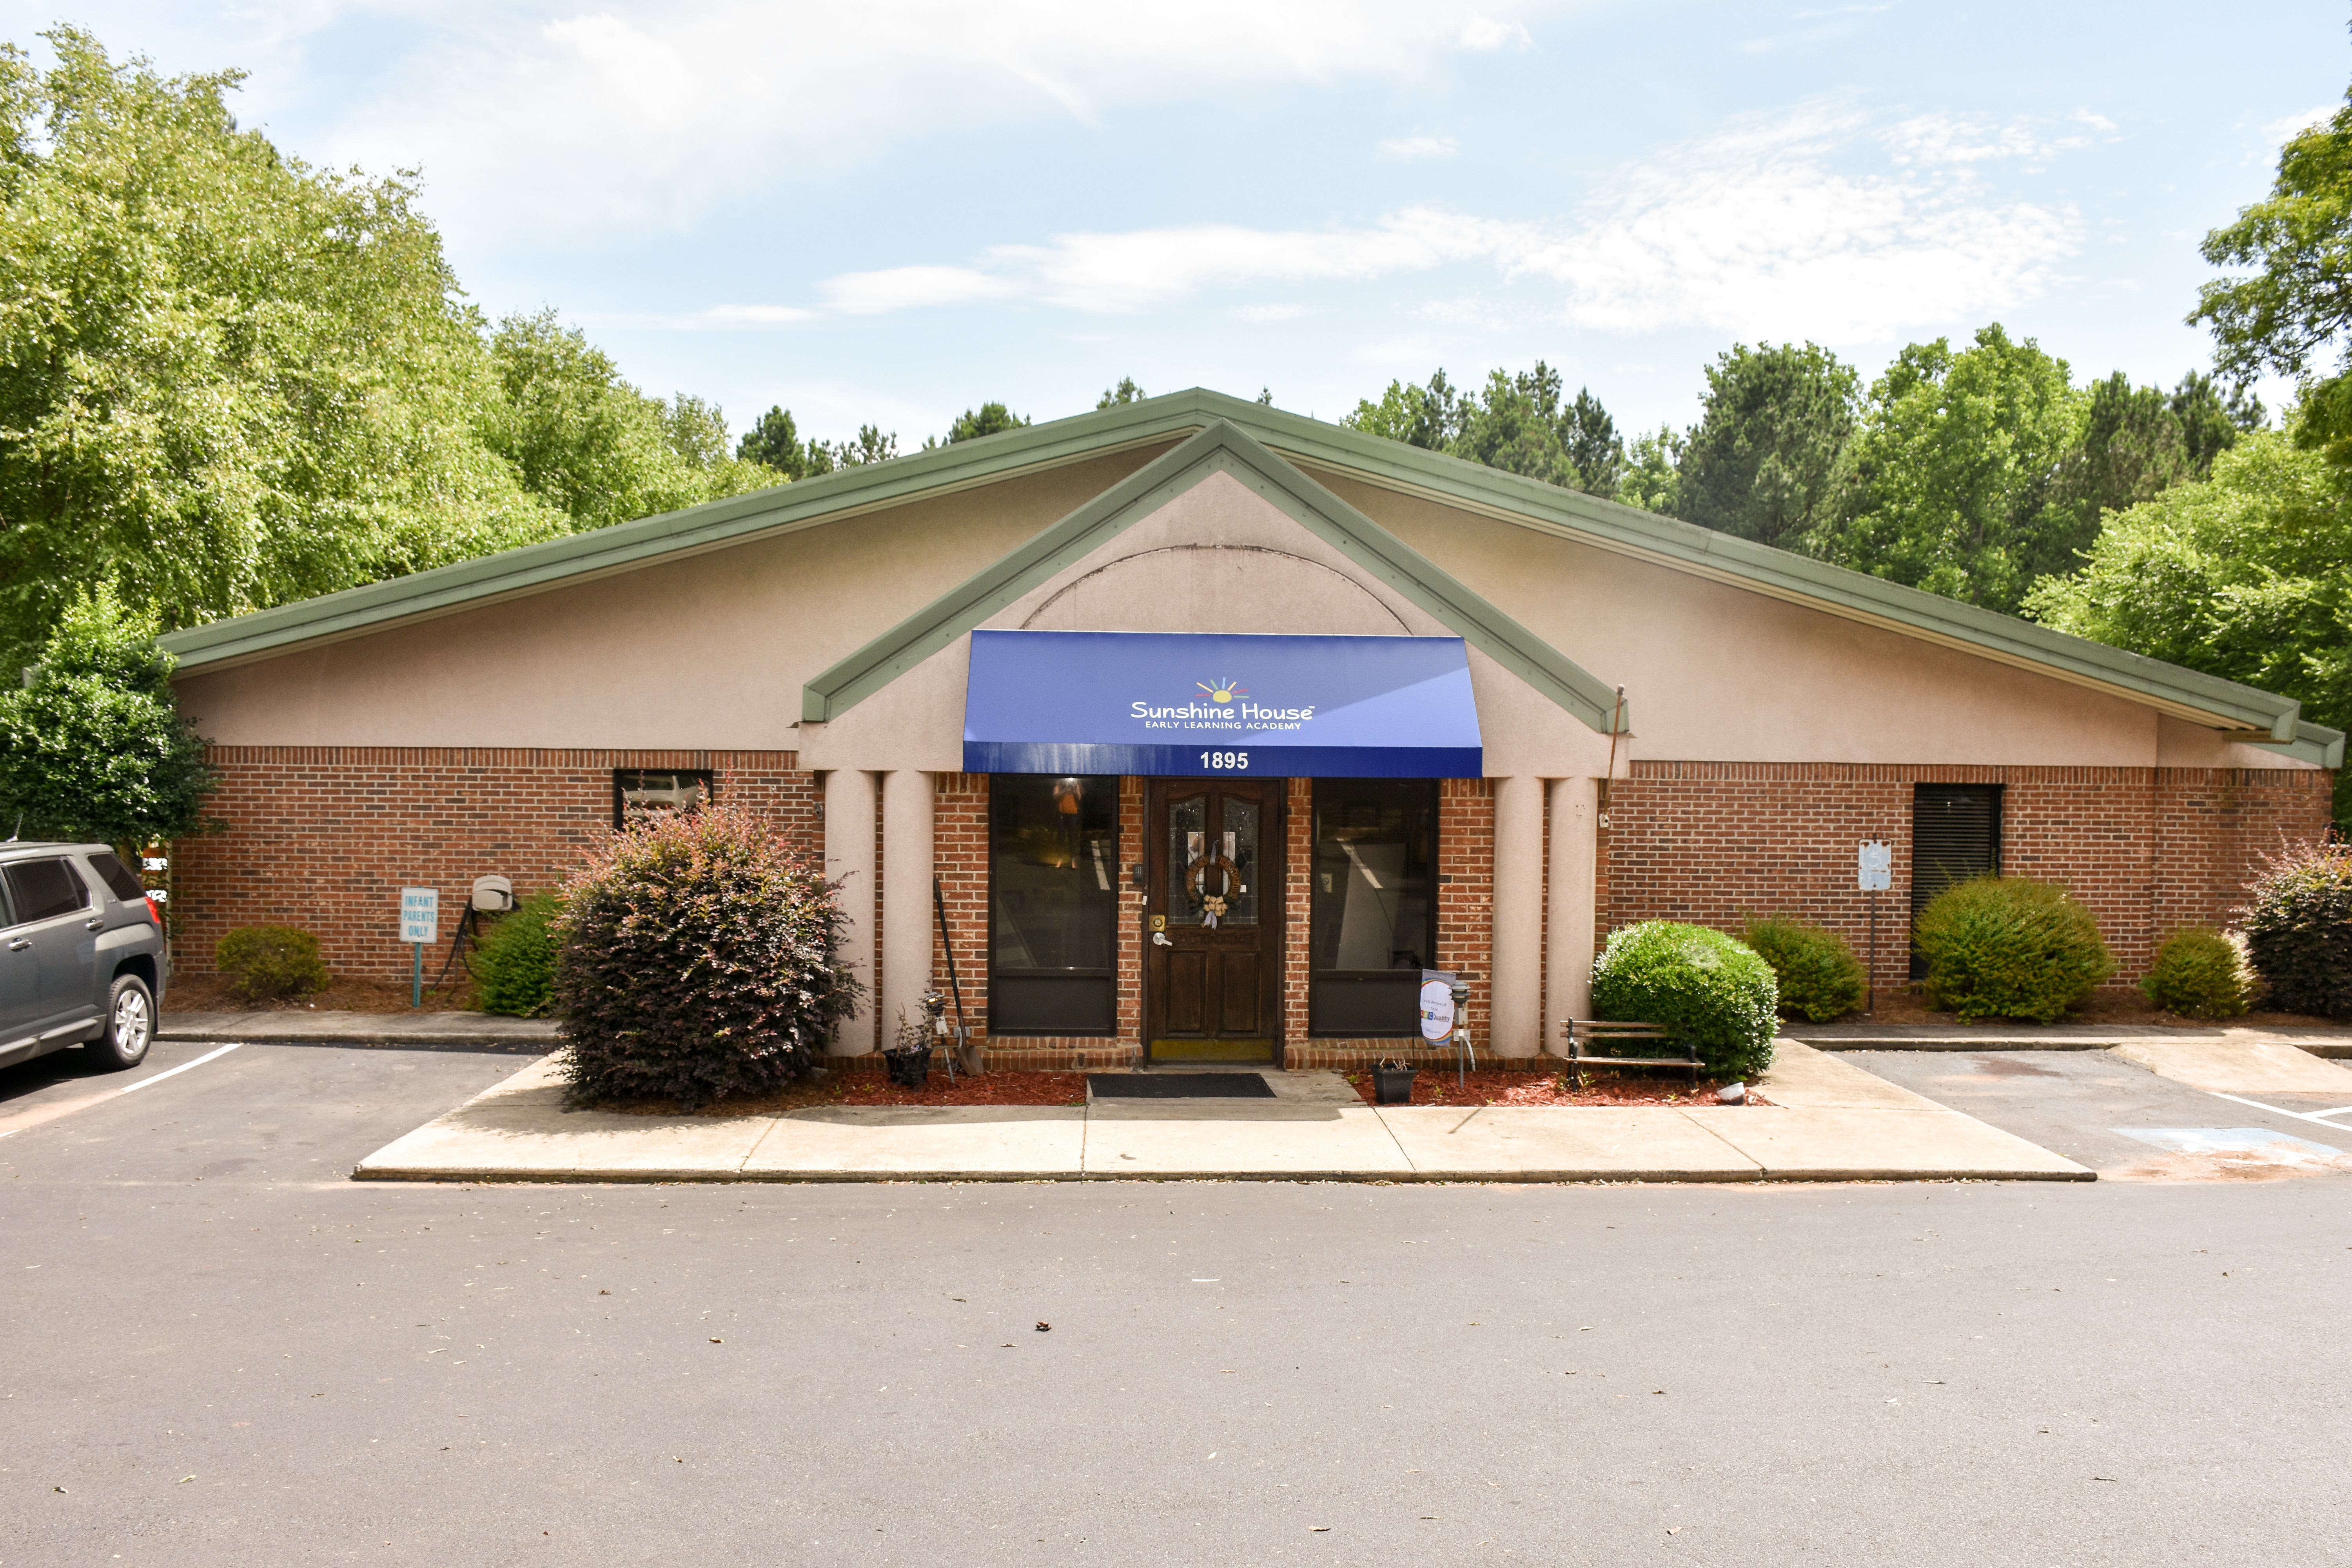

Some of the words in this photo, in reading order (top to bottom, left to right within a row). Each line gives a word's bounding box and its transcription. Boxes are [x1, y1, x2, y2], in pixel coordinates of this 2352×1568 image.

[1131, 702, 1235, 719] Sunshine
[1200, 752, 1248, 769] 1895
[405, 896, 434, 907] INFANT
[404, 911, 434, 922] PARENTS
[409, 926, 428, 936] ONLY
[1433, 1014, 1450, 1022] Quality
